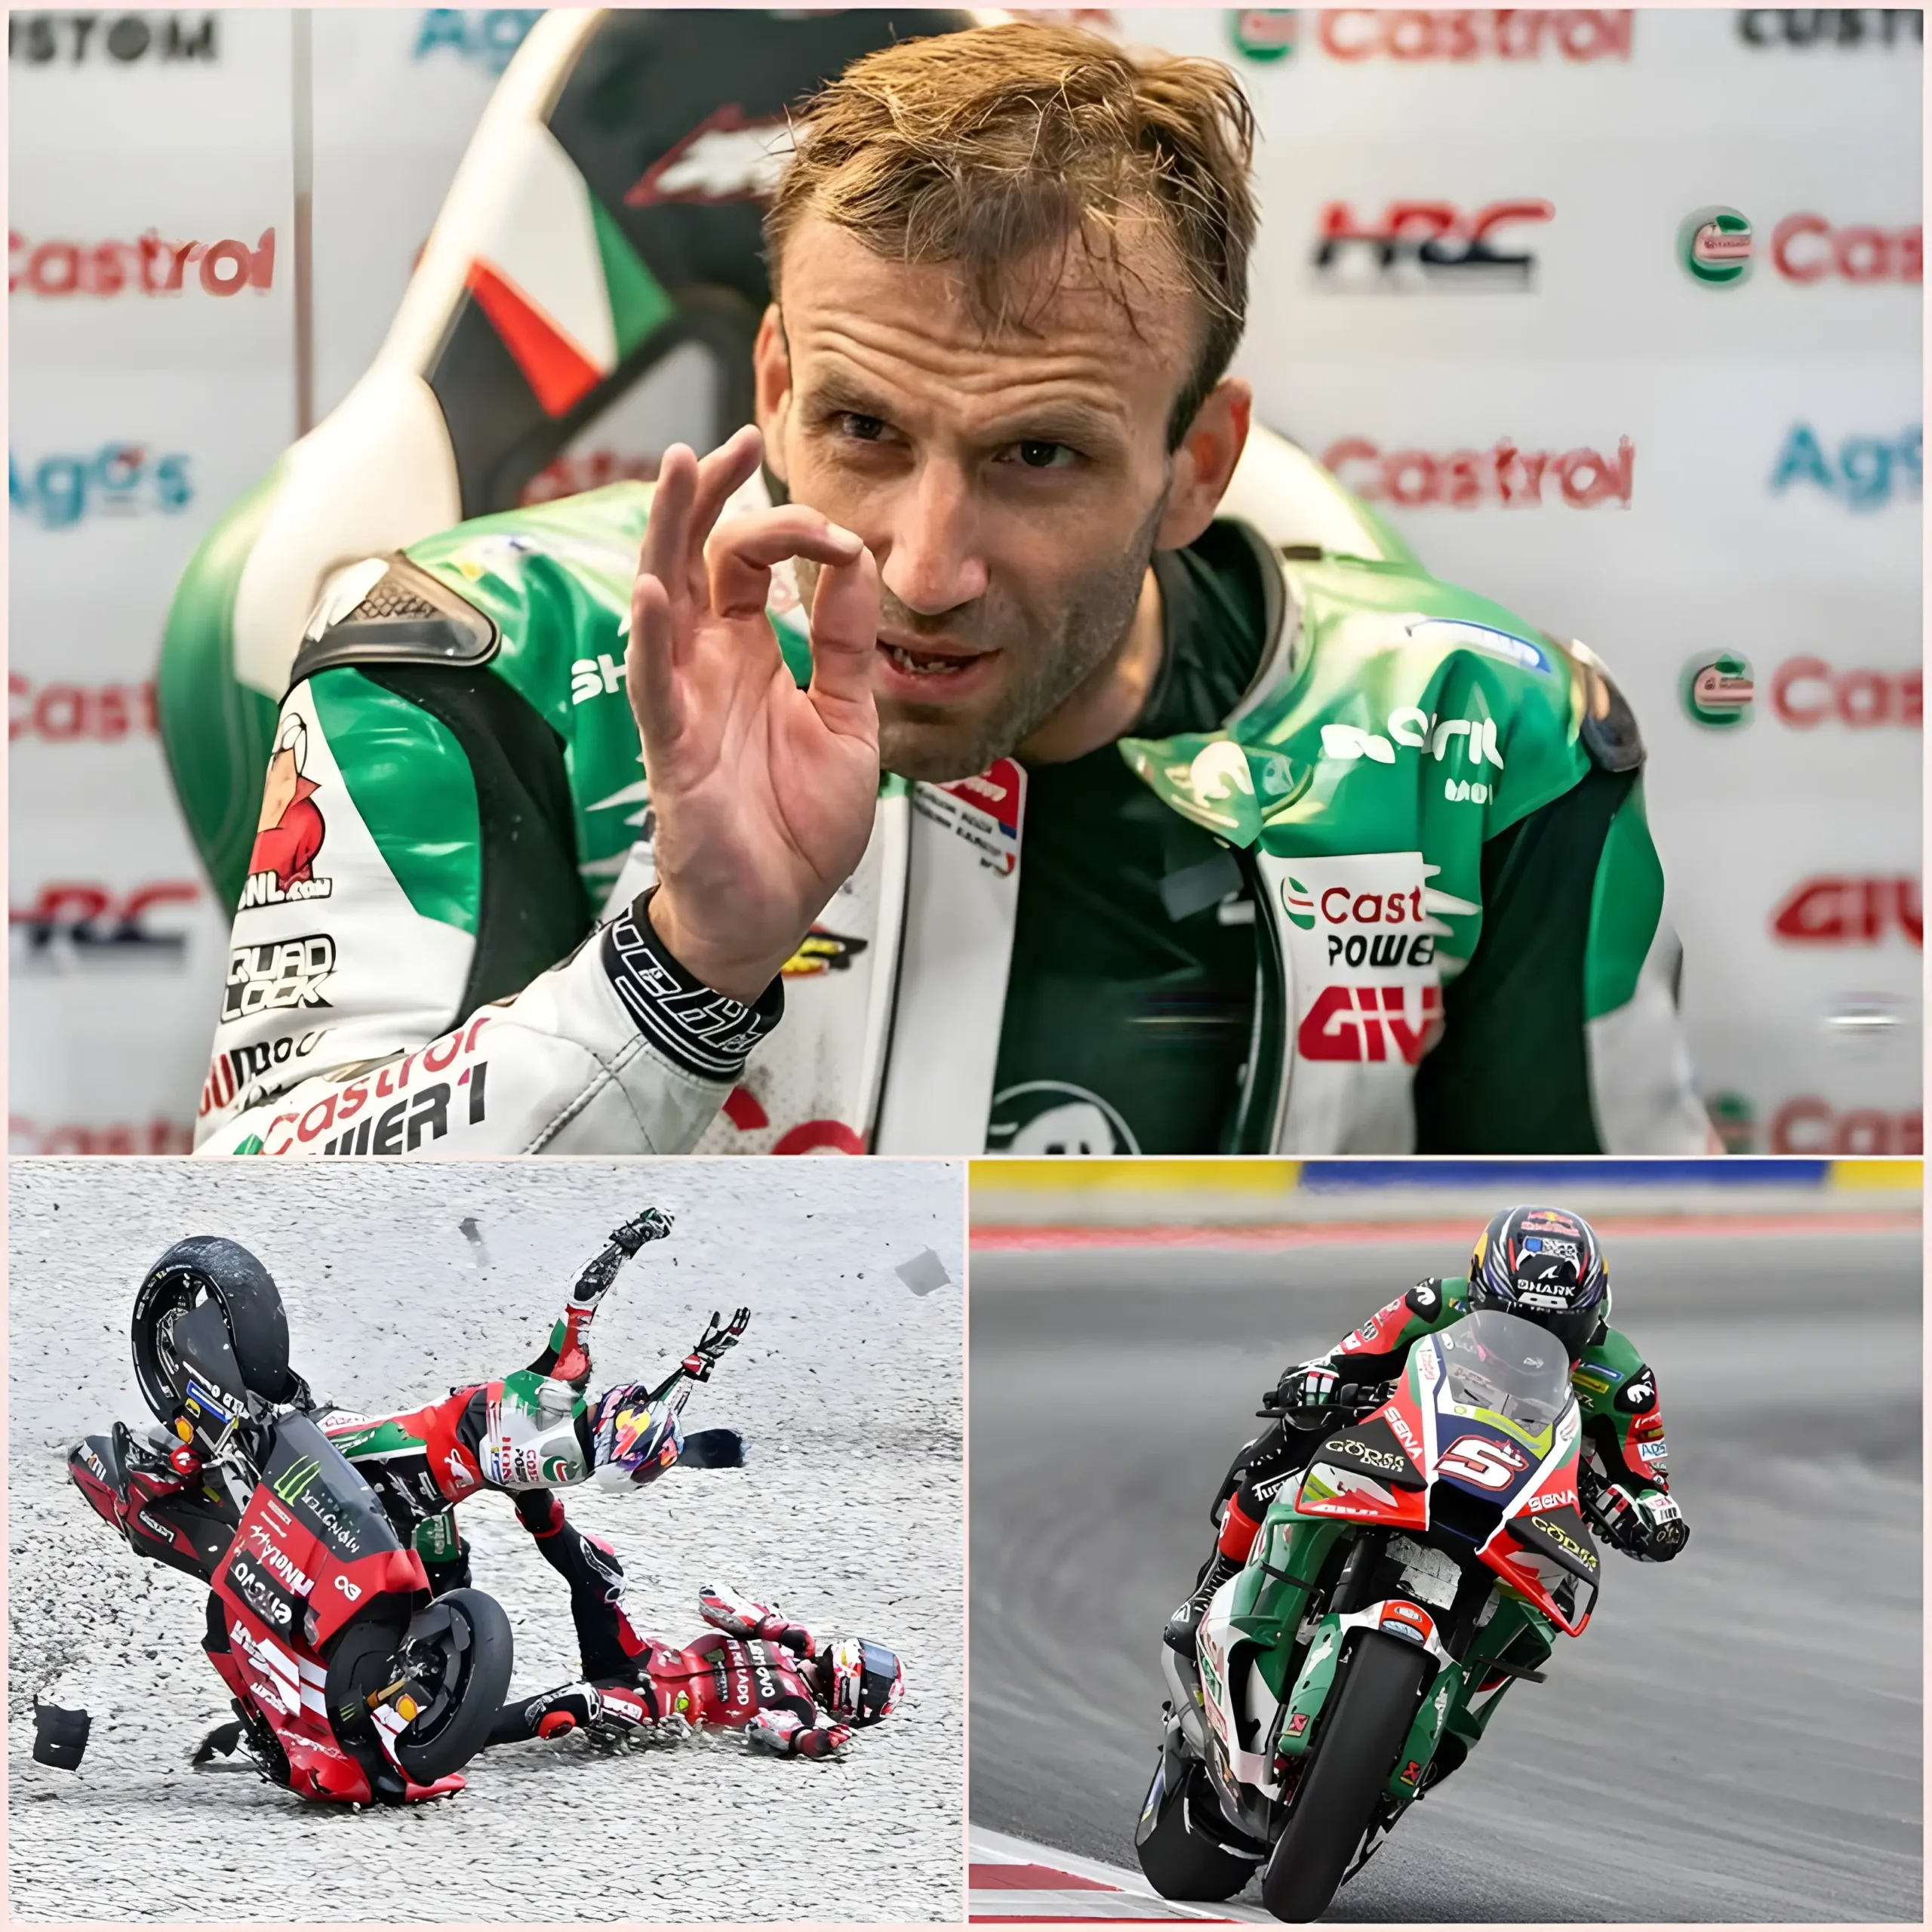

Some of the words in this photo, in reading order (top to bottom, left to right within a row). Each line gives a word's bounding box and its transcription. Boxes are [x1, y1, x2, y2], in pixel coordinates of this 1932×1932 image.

[9, 15, 219, 63] STOM
[1316, 9, 1633, 63] Castrol
[9, 226, 275, 297] astrol
[221, 972, 335, 1023] LOCK
[1383, 1406, 1424, 1460] SENA
[1433, 1435, 1530, 1492] 5
[1527, 1489, 1579, 1512] SENA
